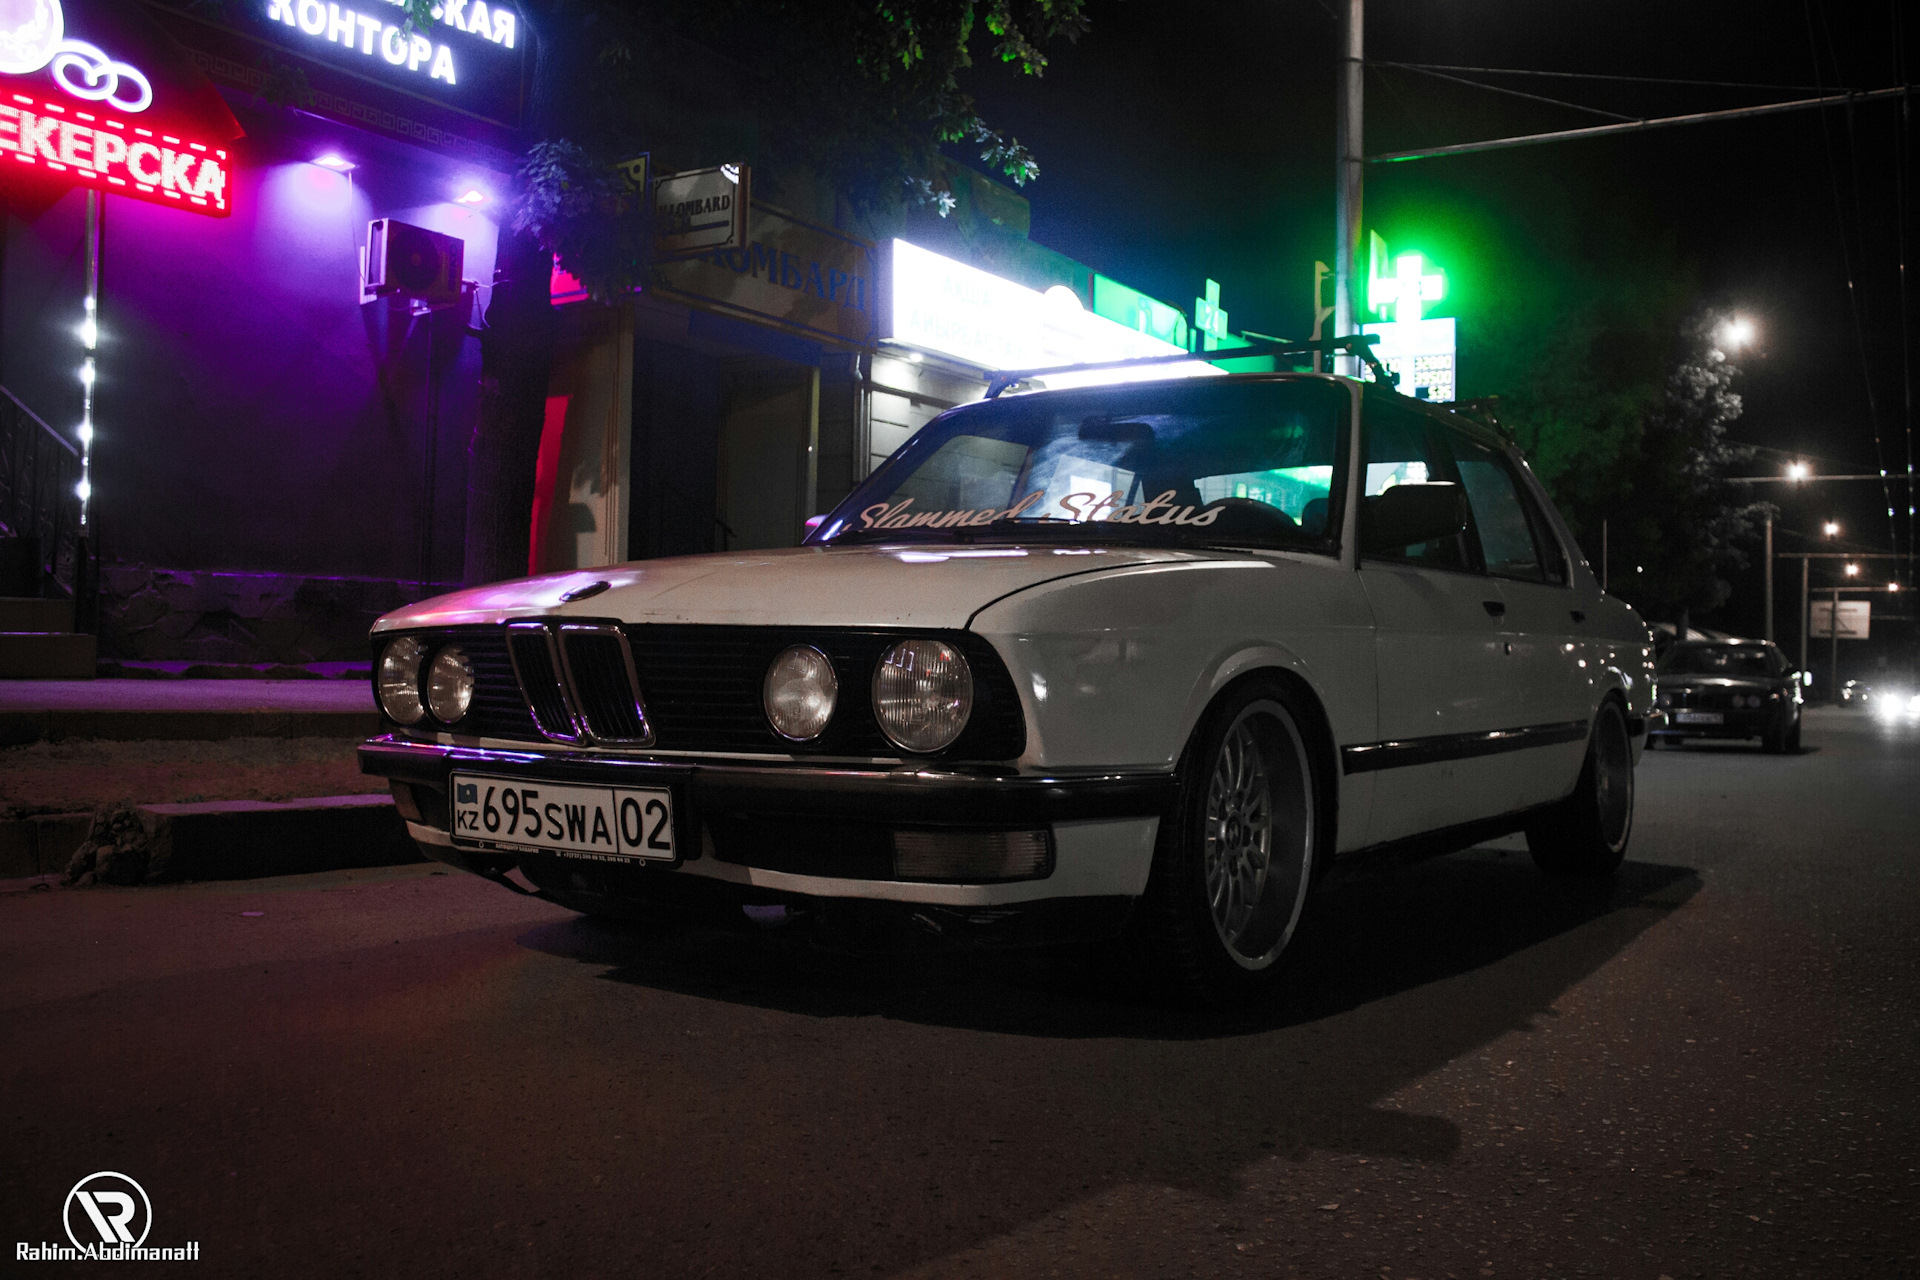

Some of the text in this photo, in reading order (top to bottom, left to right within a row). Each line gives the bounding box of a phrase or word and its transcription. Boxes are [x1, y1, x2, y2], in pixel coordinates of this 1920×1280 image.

[846, 489, 1226, 529] Slammed Status
[457, 810, 479, 831] KZ
[620, 797, 671, 851] 02
